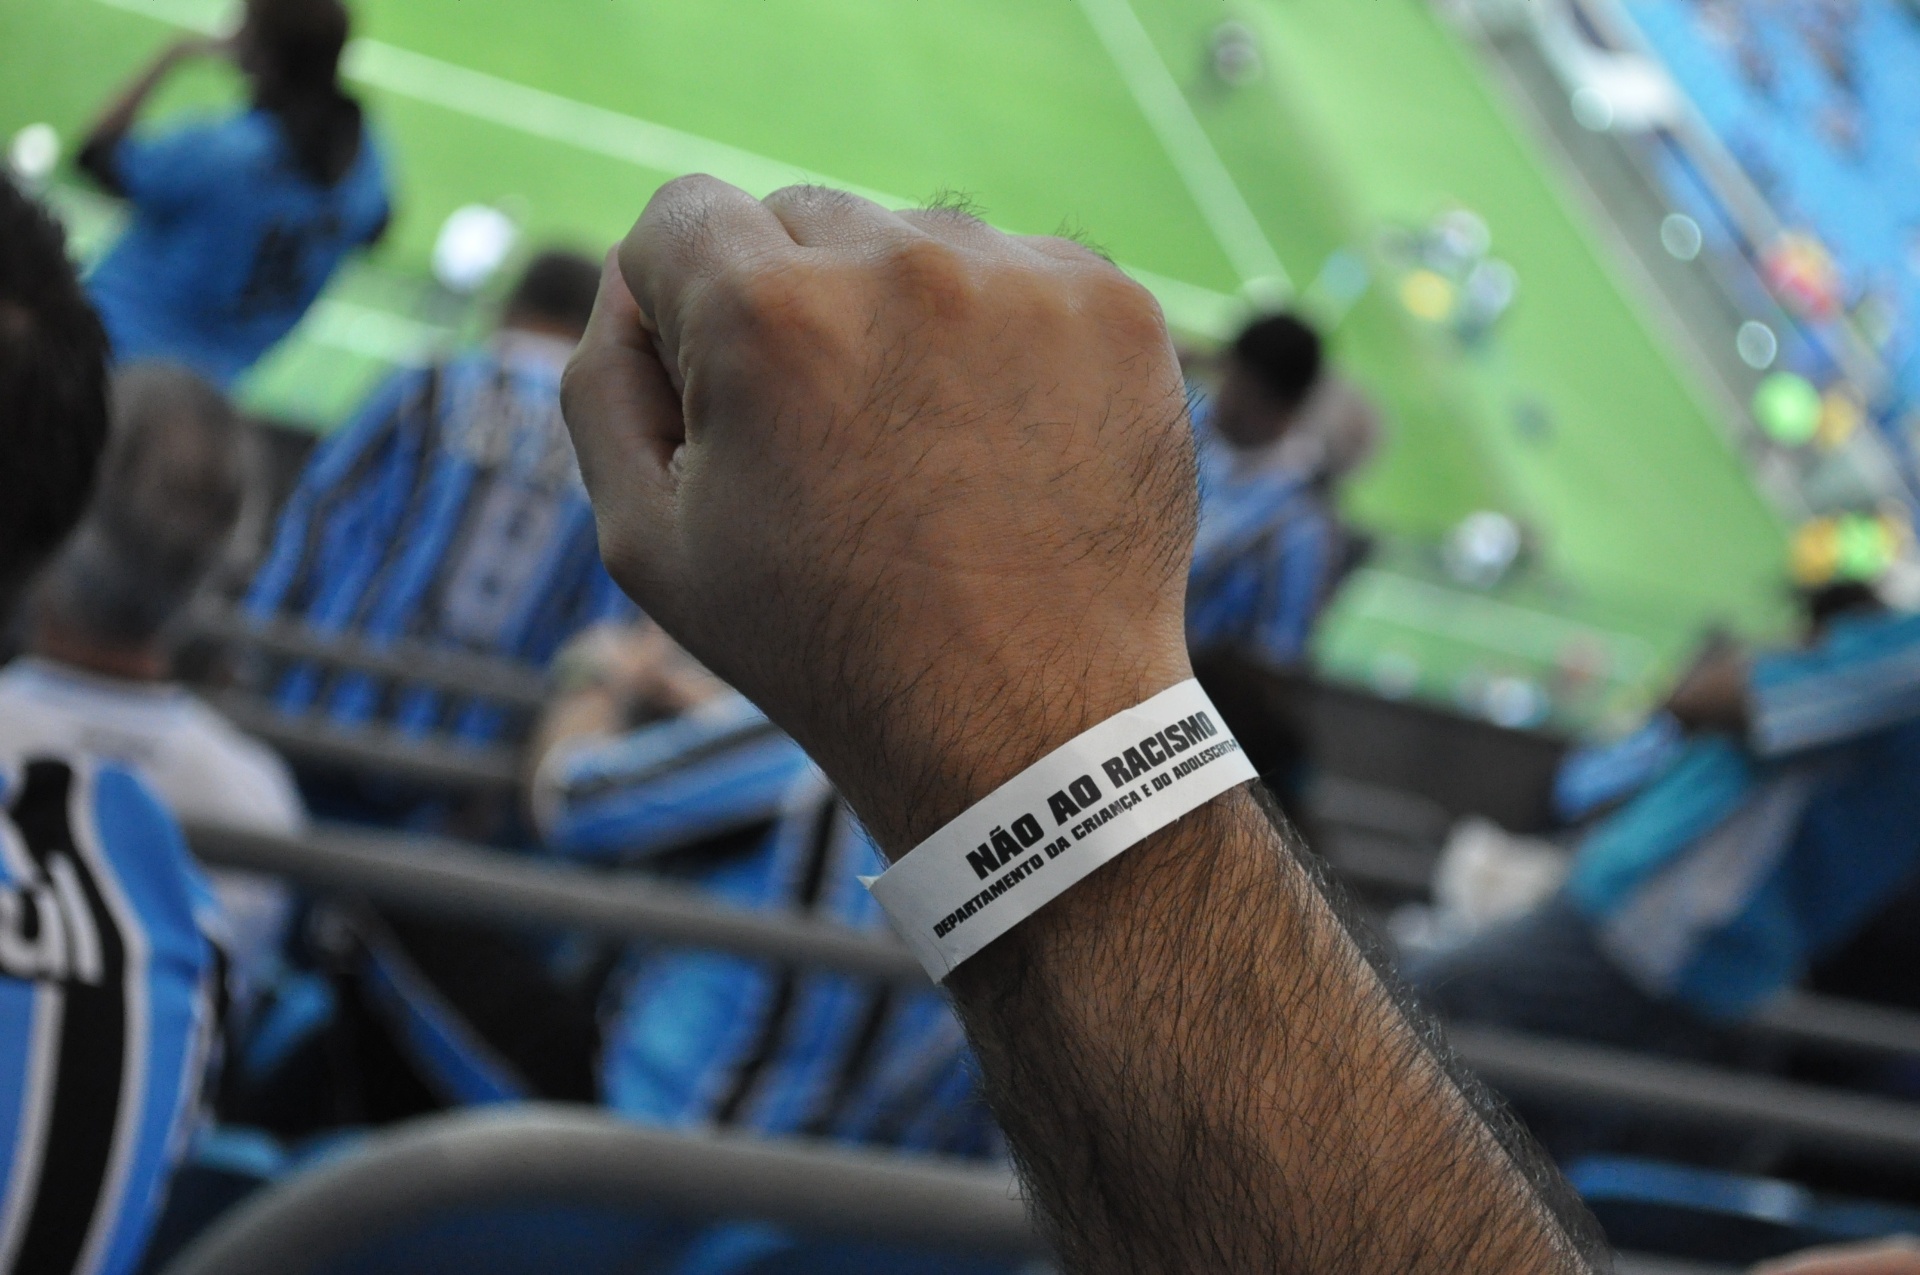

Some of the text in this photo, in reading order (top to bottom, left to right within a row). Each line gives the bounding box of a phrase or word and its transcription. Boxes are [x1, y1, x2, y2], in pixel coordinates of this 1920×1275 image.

[932, 853, 1045, 939] DEPARTAMENTO
[1043, 835, 1072, 860] DA
[1070, 790, 1143, 841] CRIANÇA
[1140, 783, 1153, 798] E
[1150, 772, 1173, 792] DO
[965, 710, 1219, 881] NÃO AO RACISMO
